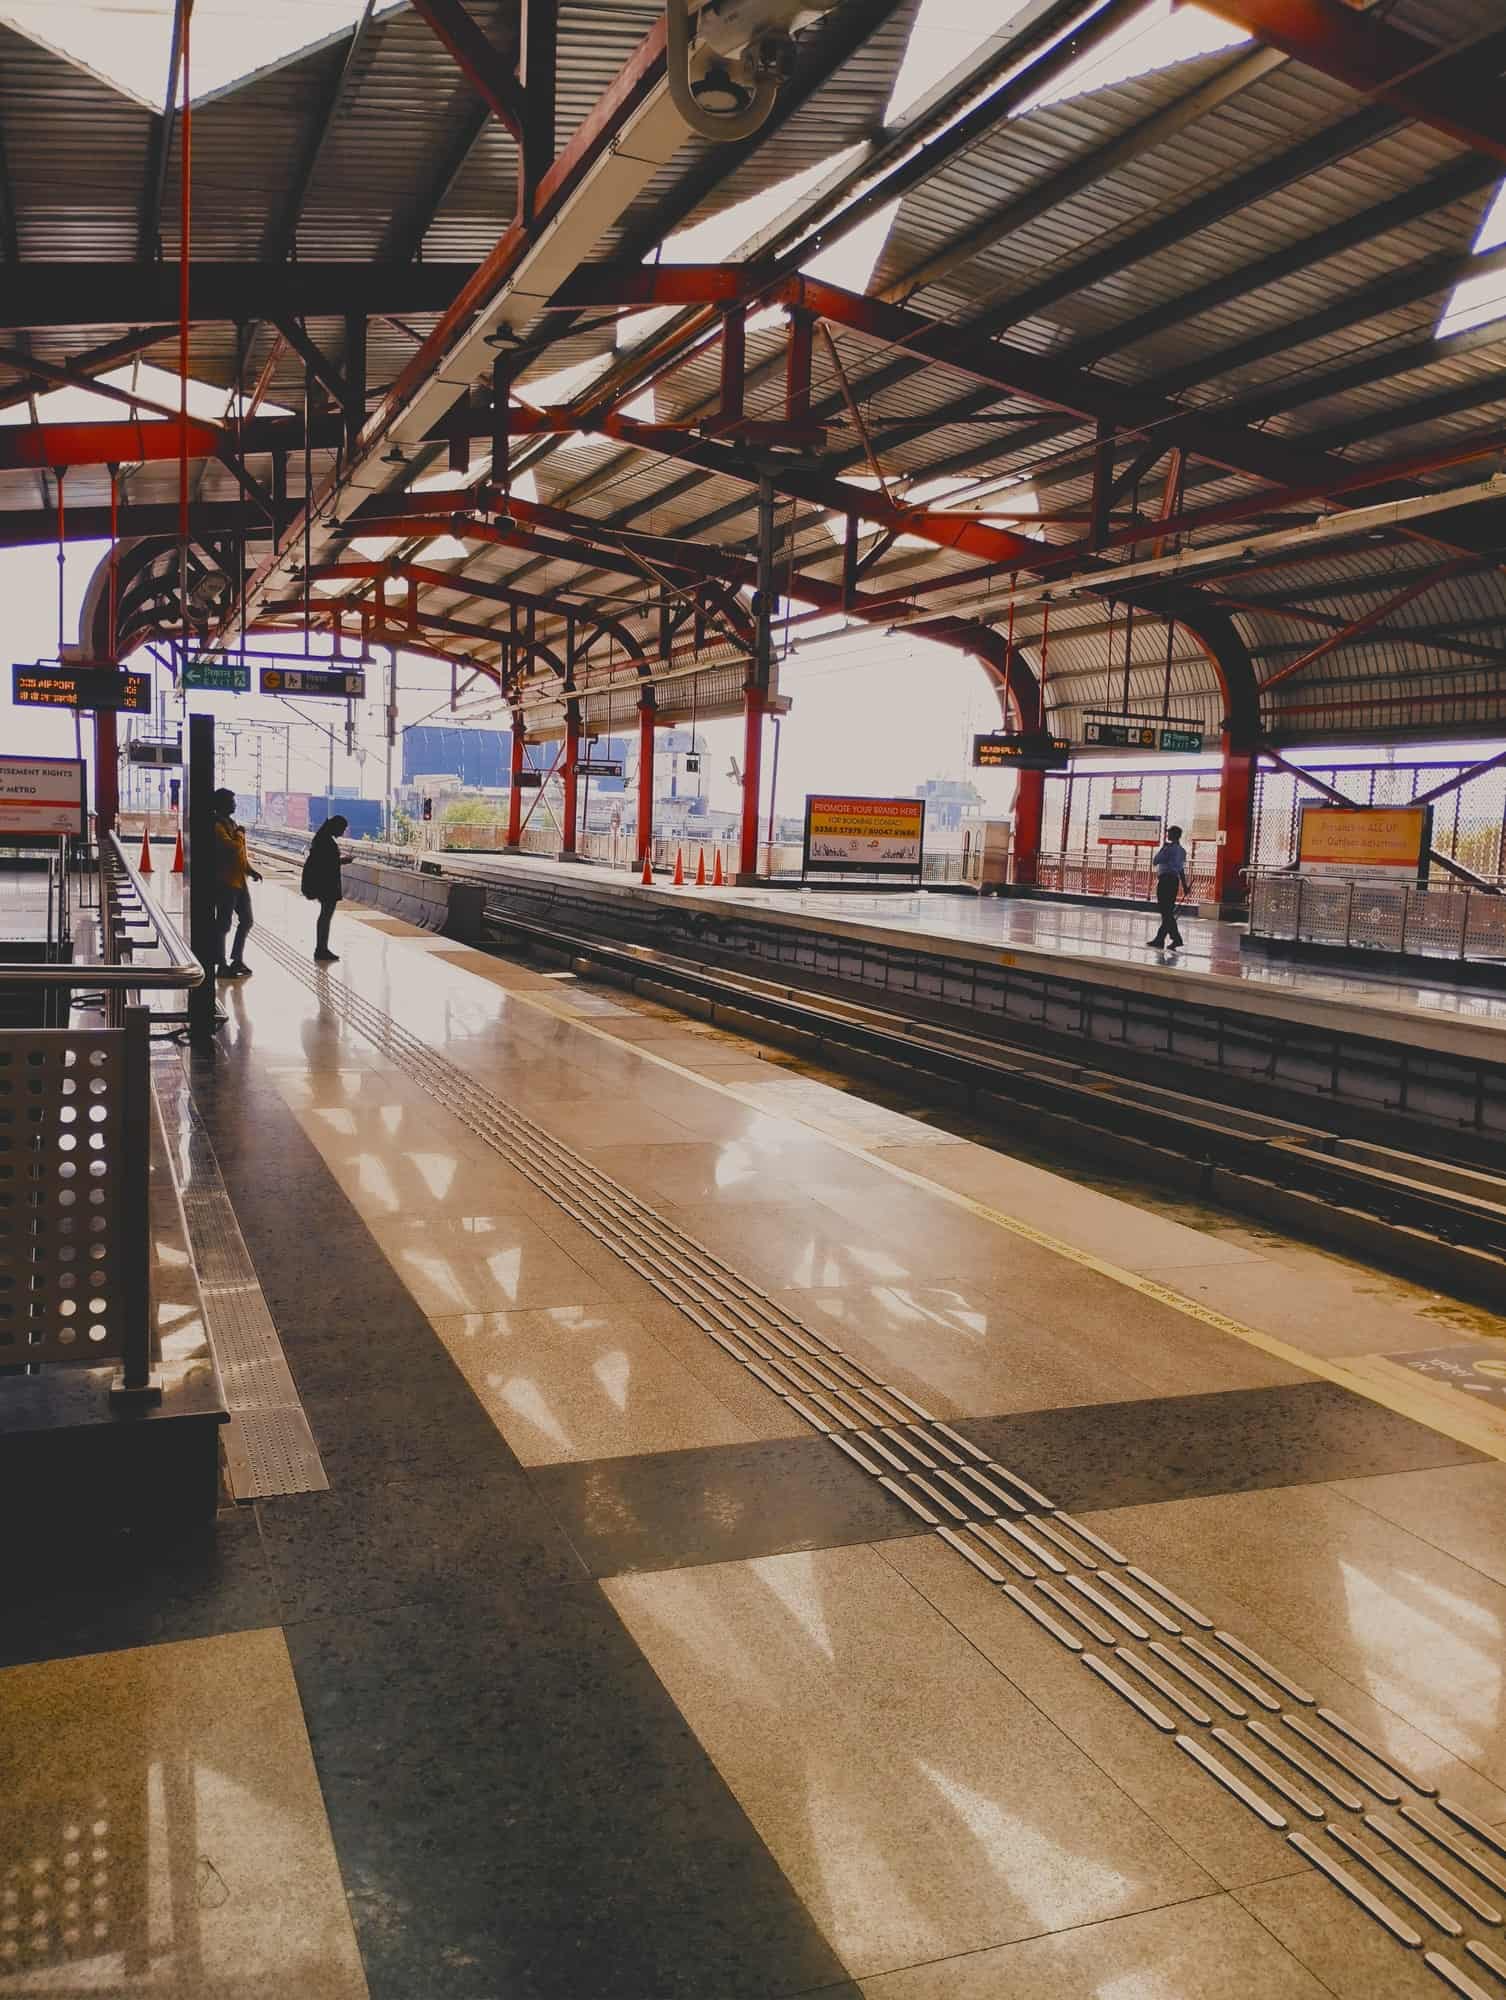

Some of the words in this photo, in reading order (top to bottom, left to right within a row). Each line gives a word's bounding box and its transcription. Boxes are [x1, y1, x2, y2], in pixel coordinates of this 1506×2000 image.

[42, 769, 72, 777] RIGHTS
[7, 784, 37, 794] METRO
[814, 803, 853, 813] PROMOTE
[853, 805, 873, 814] YOUR
